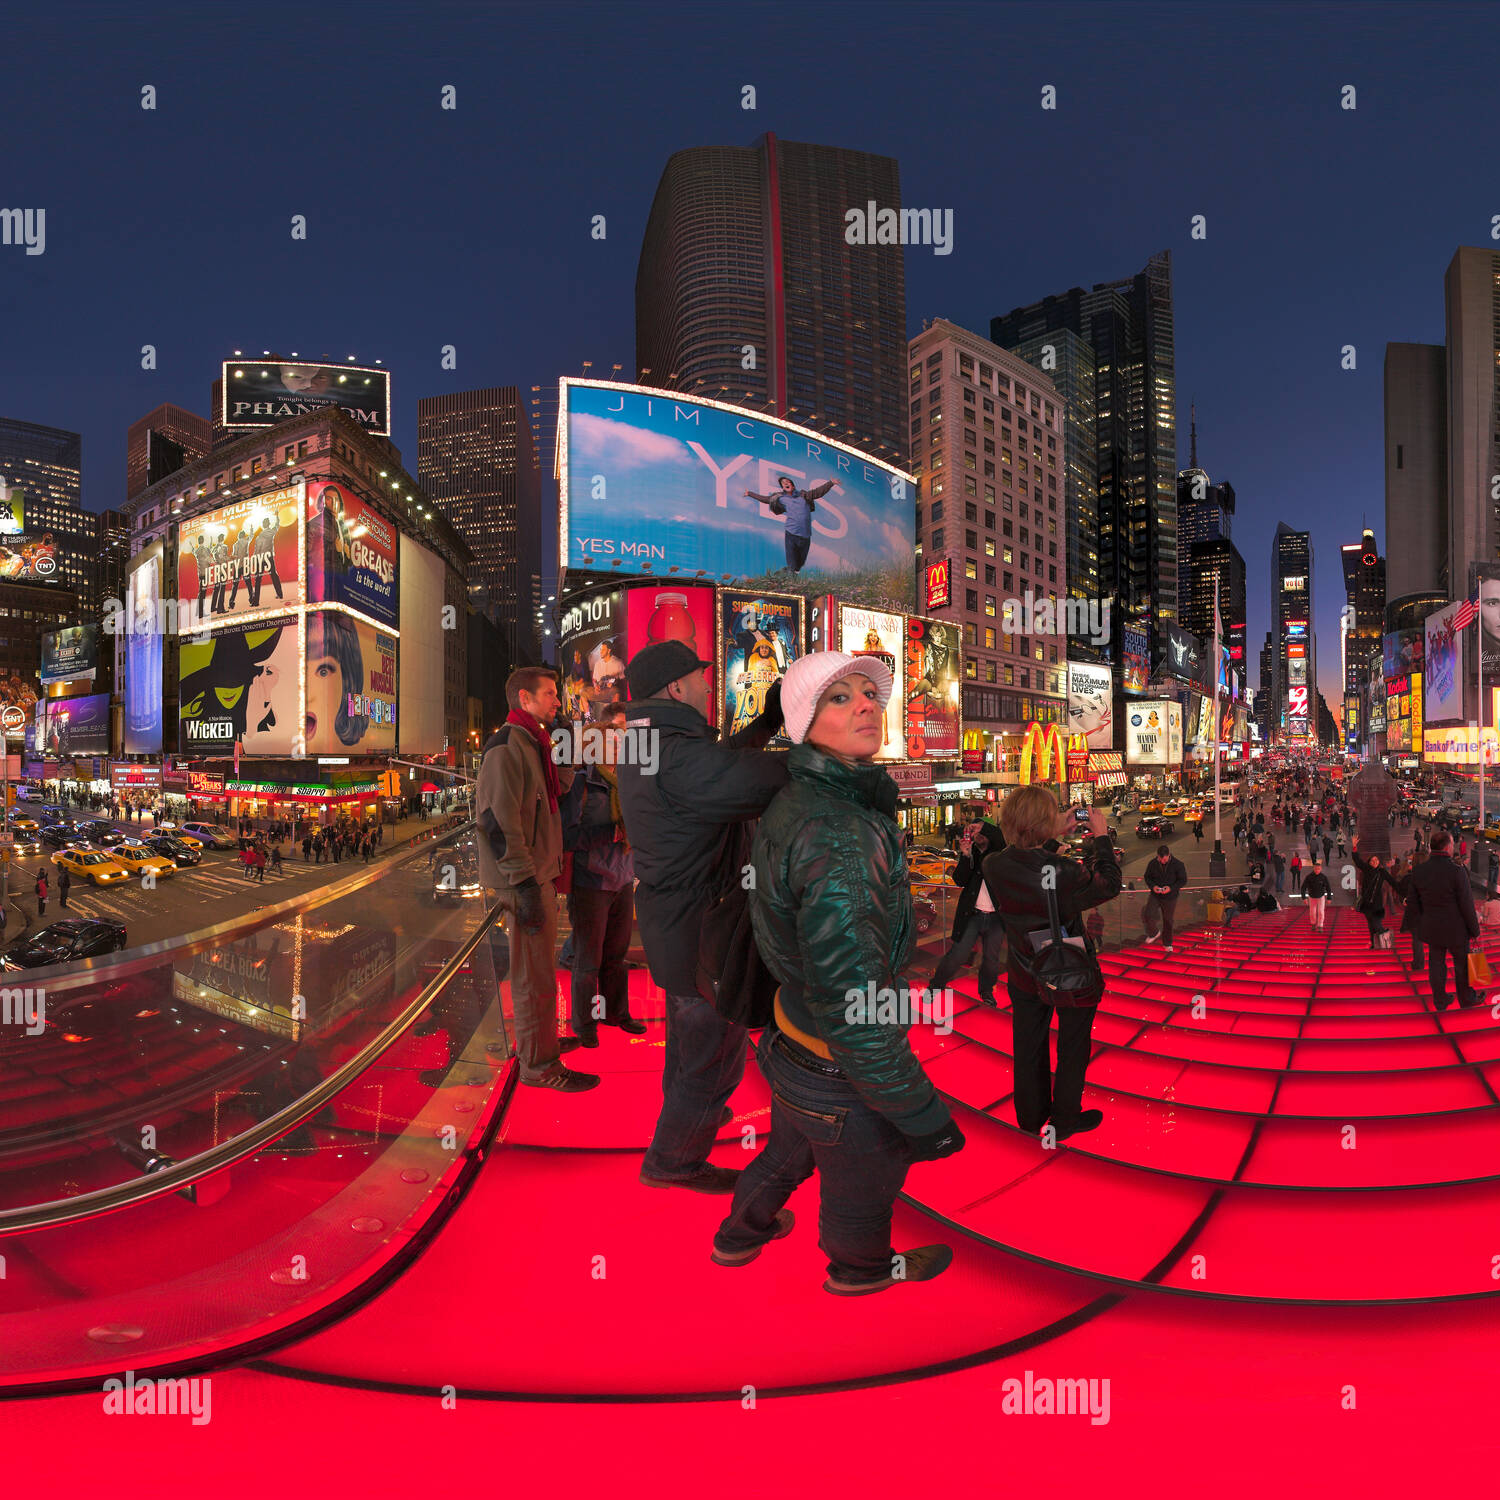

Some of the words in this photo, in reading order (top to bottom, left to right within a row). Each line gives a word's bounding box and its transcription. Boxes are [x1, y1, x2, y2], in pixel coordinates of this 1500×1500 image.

[304, 396, 329, 405] belongs
[607, 396, 700, 426] JIM
[736, 421, 899, 490] CARREY
[686, 440, 850, 540] YES
[182, 512, 219, 531] BEST
[223, 490, 297, 516] MUSICAL
[358, 514, 371, 529] ACE
[370, 522, 391, 543] YOUNG
[576, 536, 615, 554] YES
[620, 540, 665, 560] MAN
[38, 563, 53, 571] TNT
[202, 559, 241, 586] JERSEY
[243, 552, 272, 577] BOYS
[351, 541, 394, 584] GREASE
[356, 571, 362, 583] is
[363, 575, 374, 589] the
[374, 583, 391, 597] word!
[1285, 579, 1303, 588] VOTE!
[586, 598, 611, 622] 101
[880, 596, 913, 614] 12.19.08
[843, 609, 900, 625] BROADWAY
[843, 619, 867, 628] GOES
[869, 623, 900, 634] BLONDE
[1125, 631, 1147, 648] SOUTH
[1125, 641, 1148, 657] PACIFIC
[382, 655, 394, 676] BEST
[370, 670, 394, 696] MUSICAL
[1072, 676, 1110, 686] MAXIMUM
[1072, 682, 1109, 690] PERFORMANCE
[1387, 676, 1408, 696] Kodak
[348, 693, 396, 724] hairspray
[1372, 705, 1383, 718] UFC
[1412, 694, 1422, 733] Kodak
[1137, 734, 1157, 744] MAMMA
[1425, 740, 1441, 752] Bank
[1442, 740, 1449, 752] of
[1141, 743, 1153, 753] MIA!
[894, 770, 928, 780] BLONDE
[200, 782, 222, 791] STEAKS
[229, 783, 252, 791] sbarro
[261, 784, 287, 794] sbarro
[297, 785, 326, 796] sbarro
[942, 792, 958, 800] SHOP
